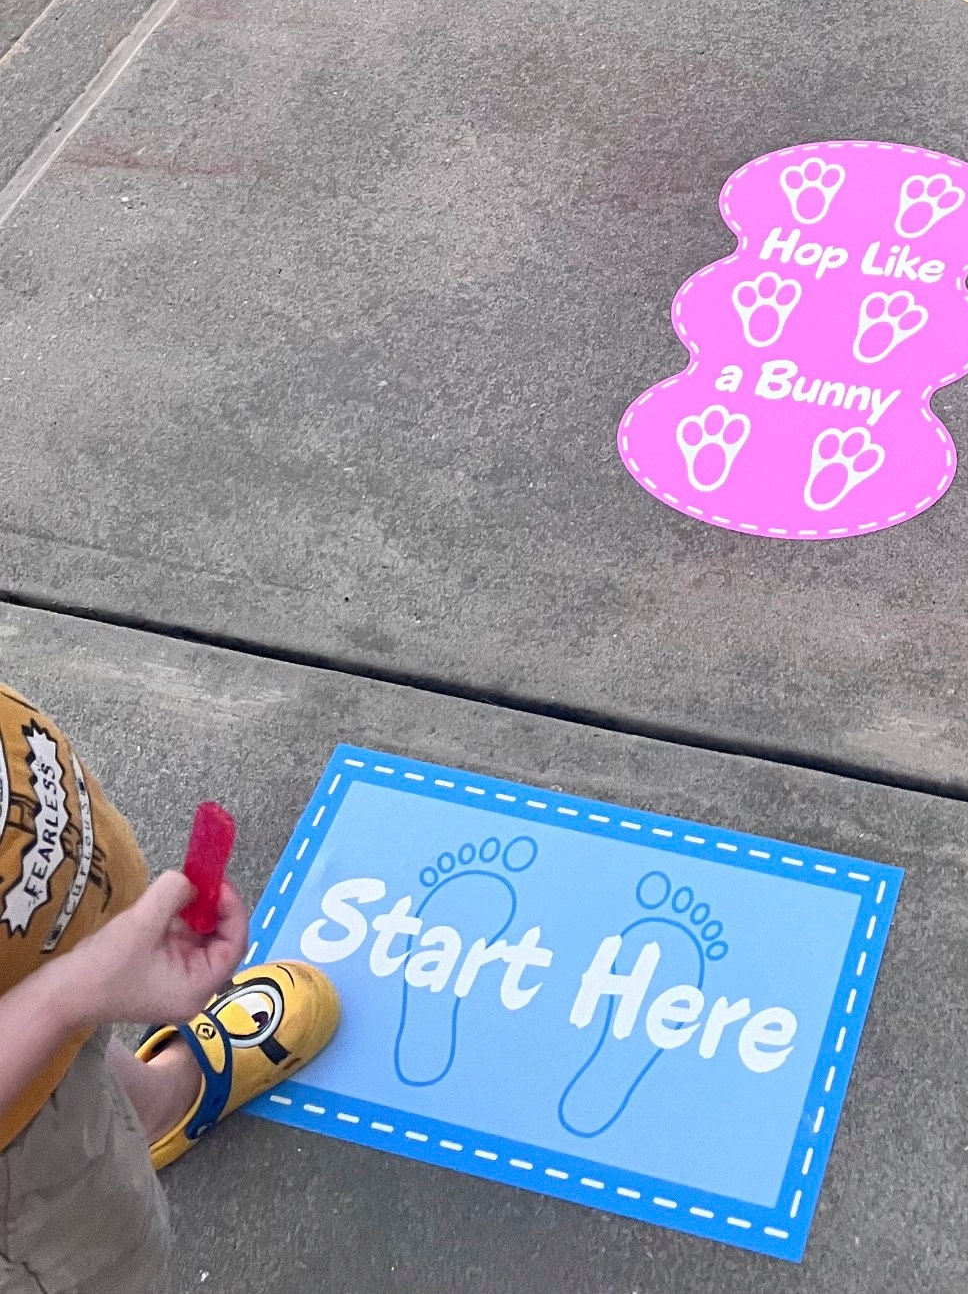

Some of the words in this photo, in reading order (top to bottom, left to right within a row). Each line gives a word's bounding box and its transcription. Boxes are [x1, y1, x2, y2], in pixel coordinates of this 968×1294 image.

[759, 227, 848, 279] Hop
[861, 241, 945, 283] Like
[715, 365, 742, 392] a
[755, 360, 901, 426] Bunny
[24, 762, 59, 898] FEARLESS
[300, 878, 553, 1010] Start
[569, 934, 798, 1073] Here
